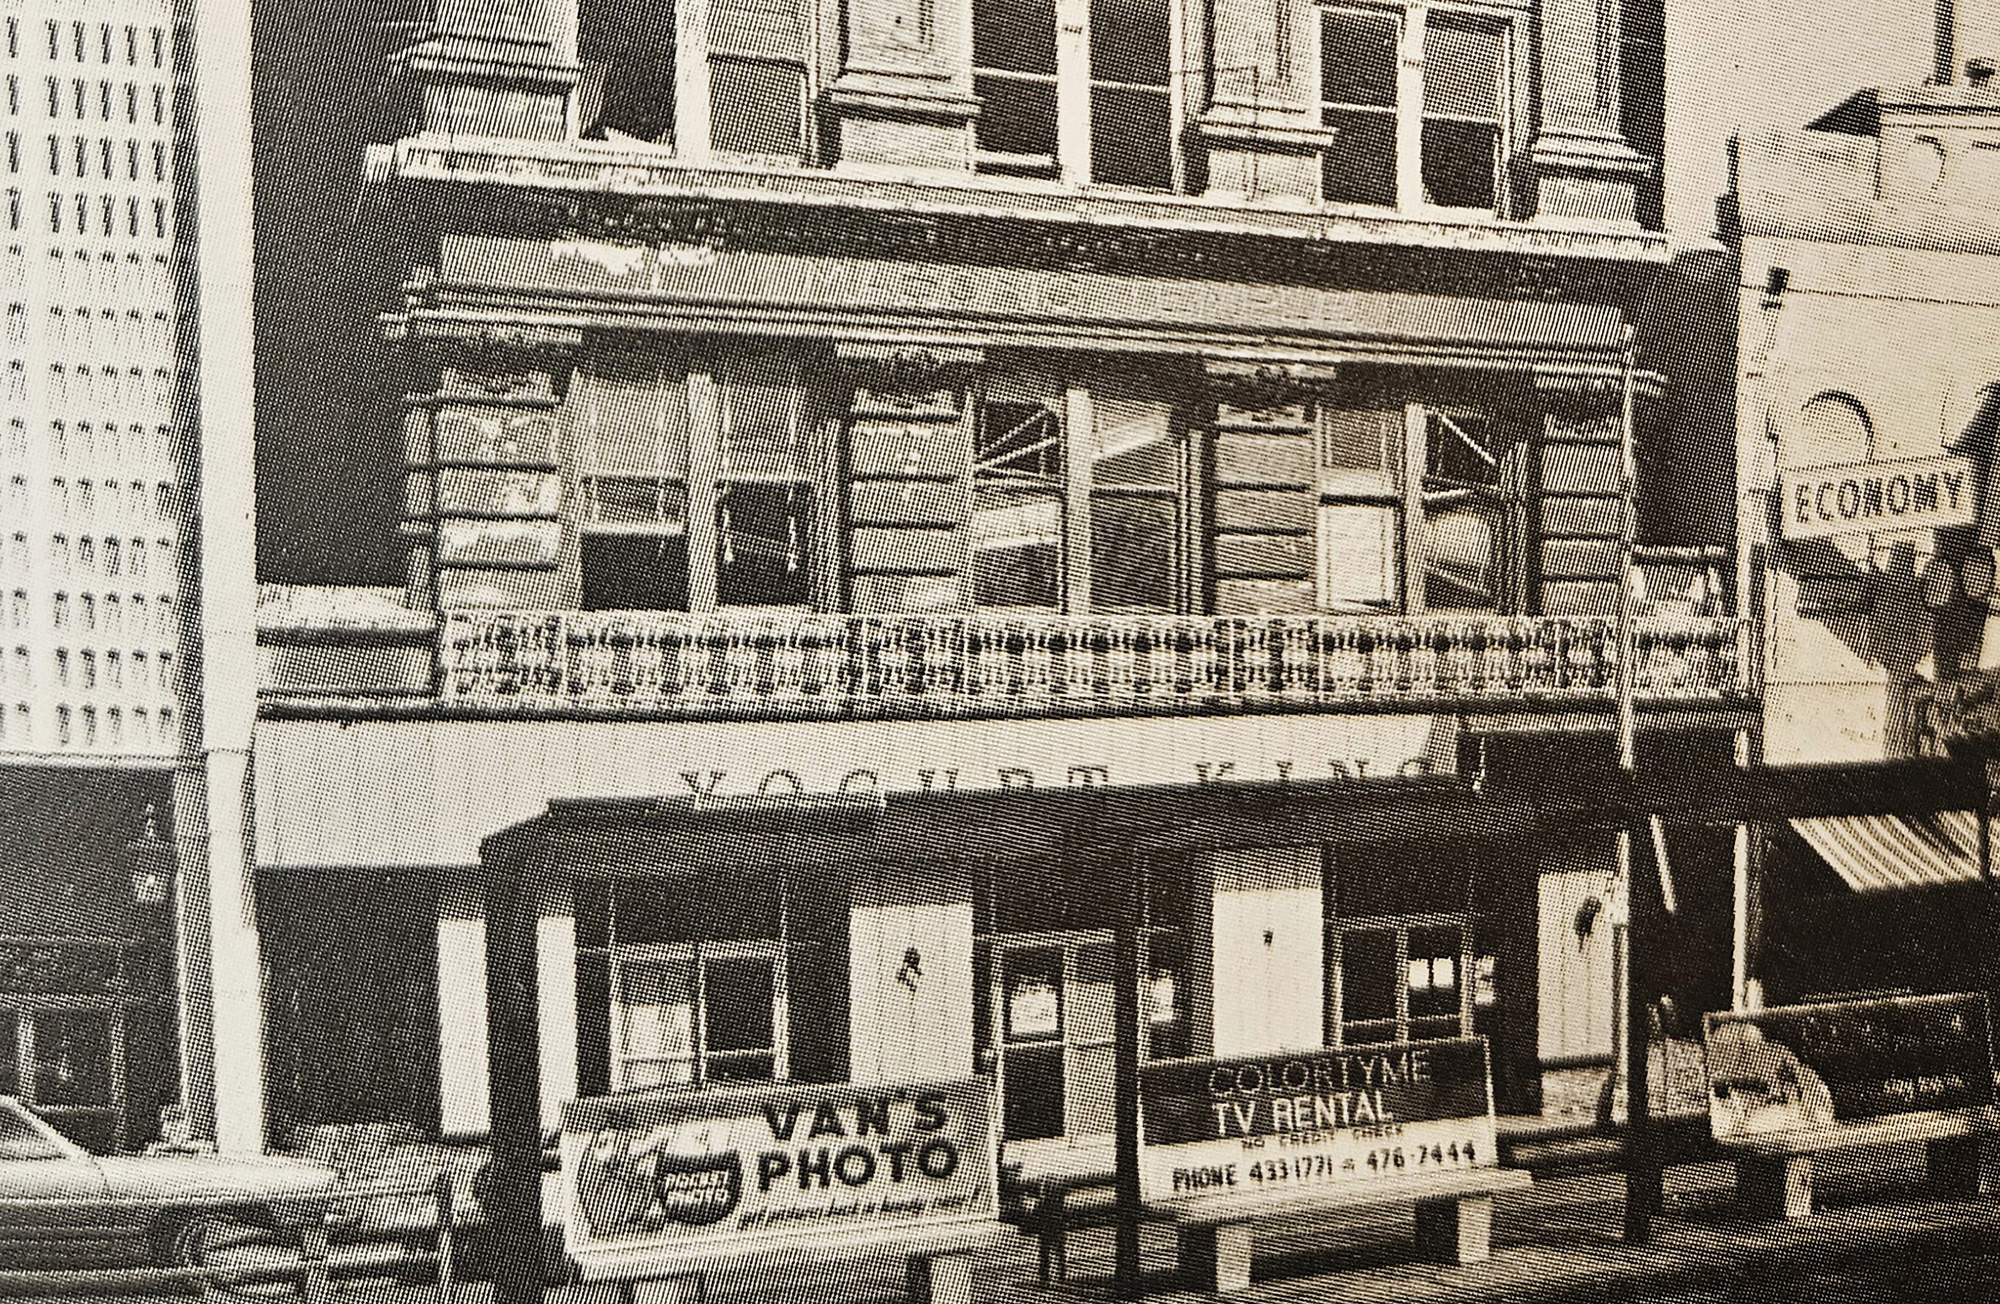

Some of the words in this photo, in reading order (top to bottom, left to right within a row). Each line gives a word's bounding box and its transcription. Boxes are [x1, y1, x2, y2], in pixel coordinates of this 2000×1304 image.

[1795, 471, 1964, 524] ECONOMY
[1208, 1048, 1431, 1095] COLORTYME
[762, 1090, 949, 1141] VAN'S
[1212, 1101, 1256, 1138] TV
[1272, 1090, 1394, 1133] RENTAL
[1241, 1136, 1266, 1150] NO
[1279, 1129, 1336, 1147] CREDIT
[758, 1136, 959, 1193] PHOTO
[1172, 1162, 1238, 1192] PHONE
